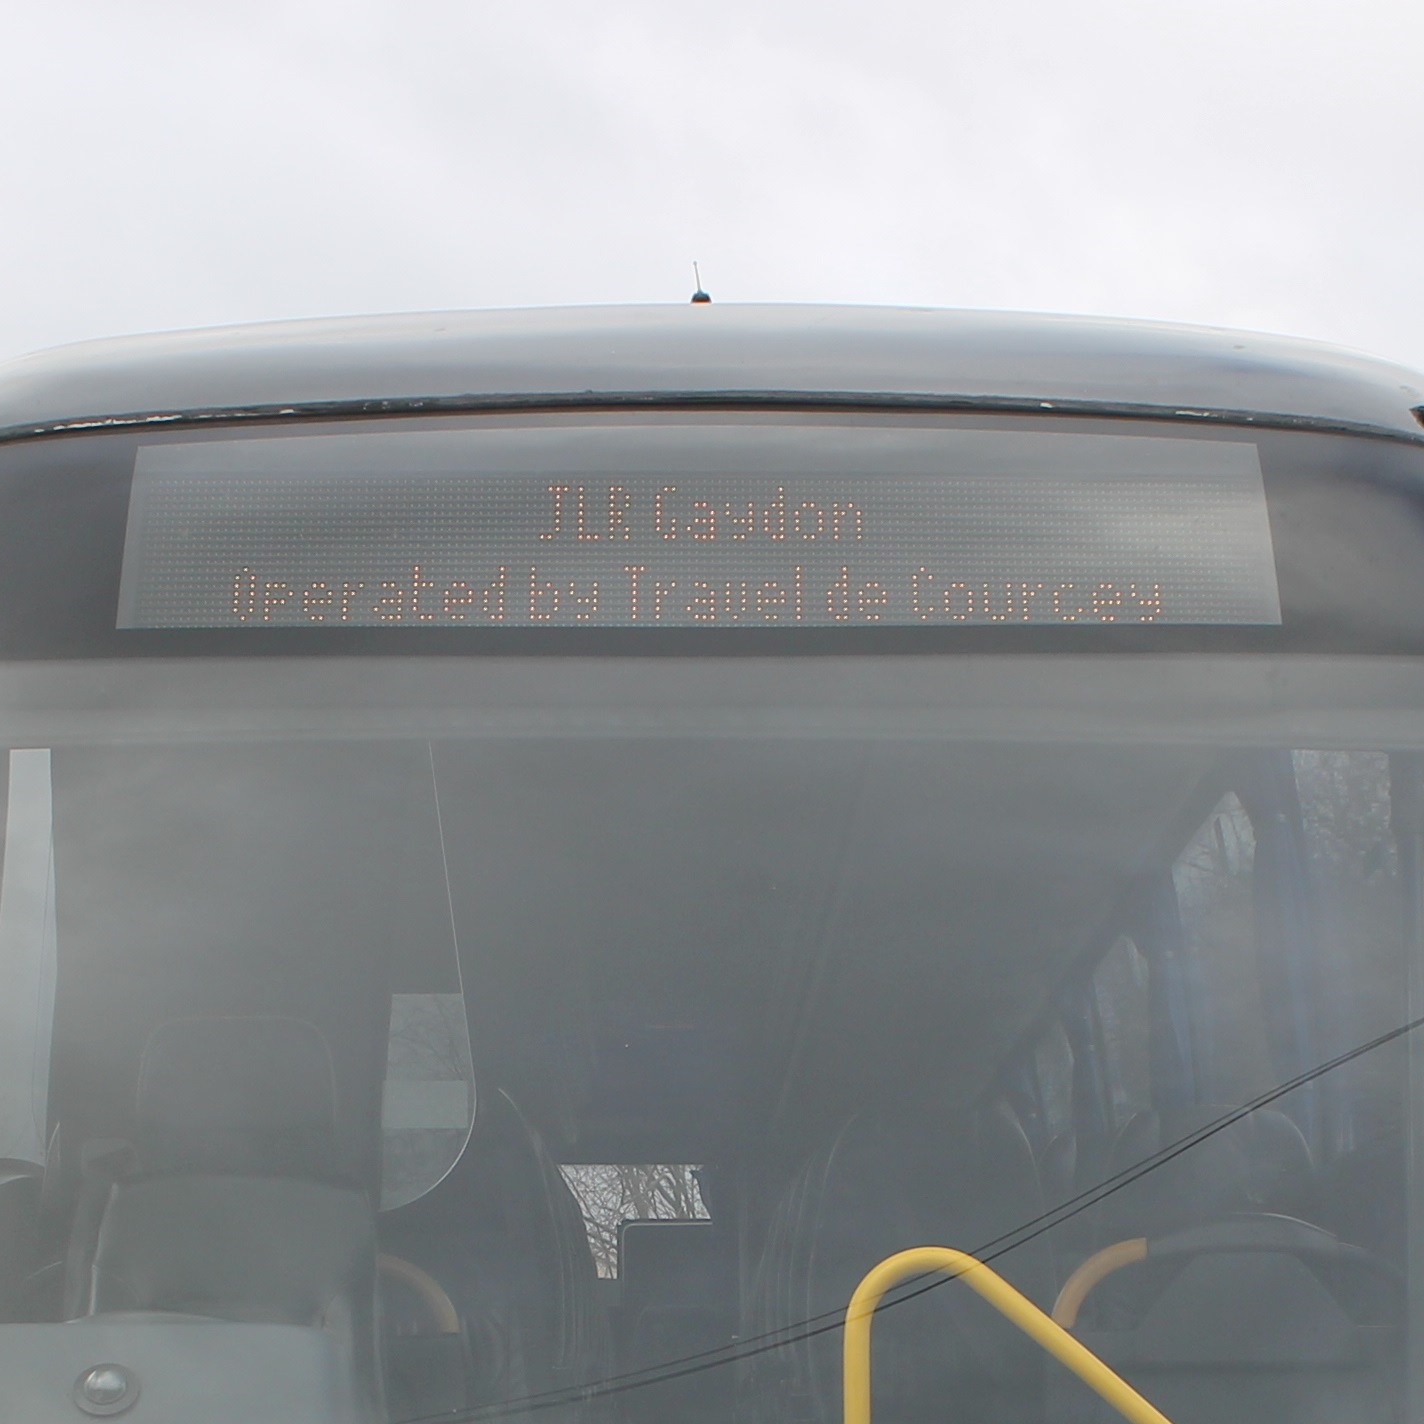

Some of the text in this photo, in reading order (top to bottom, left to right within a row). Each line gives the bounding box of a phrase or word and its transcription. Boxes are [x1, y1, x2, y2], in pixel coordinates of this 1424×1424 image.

[538, 486, 863, 540] JLR Gaydon
[232, 565, 1162, 623] Operated by Travel de Courcey
